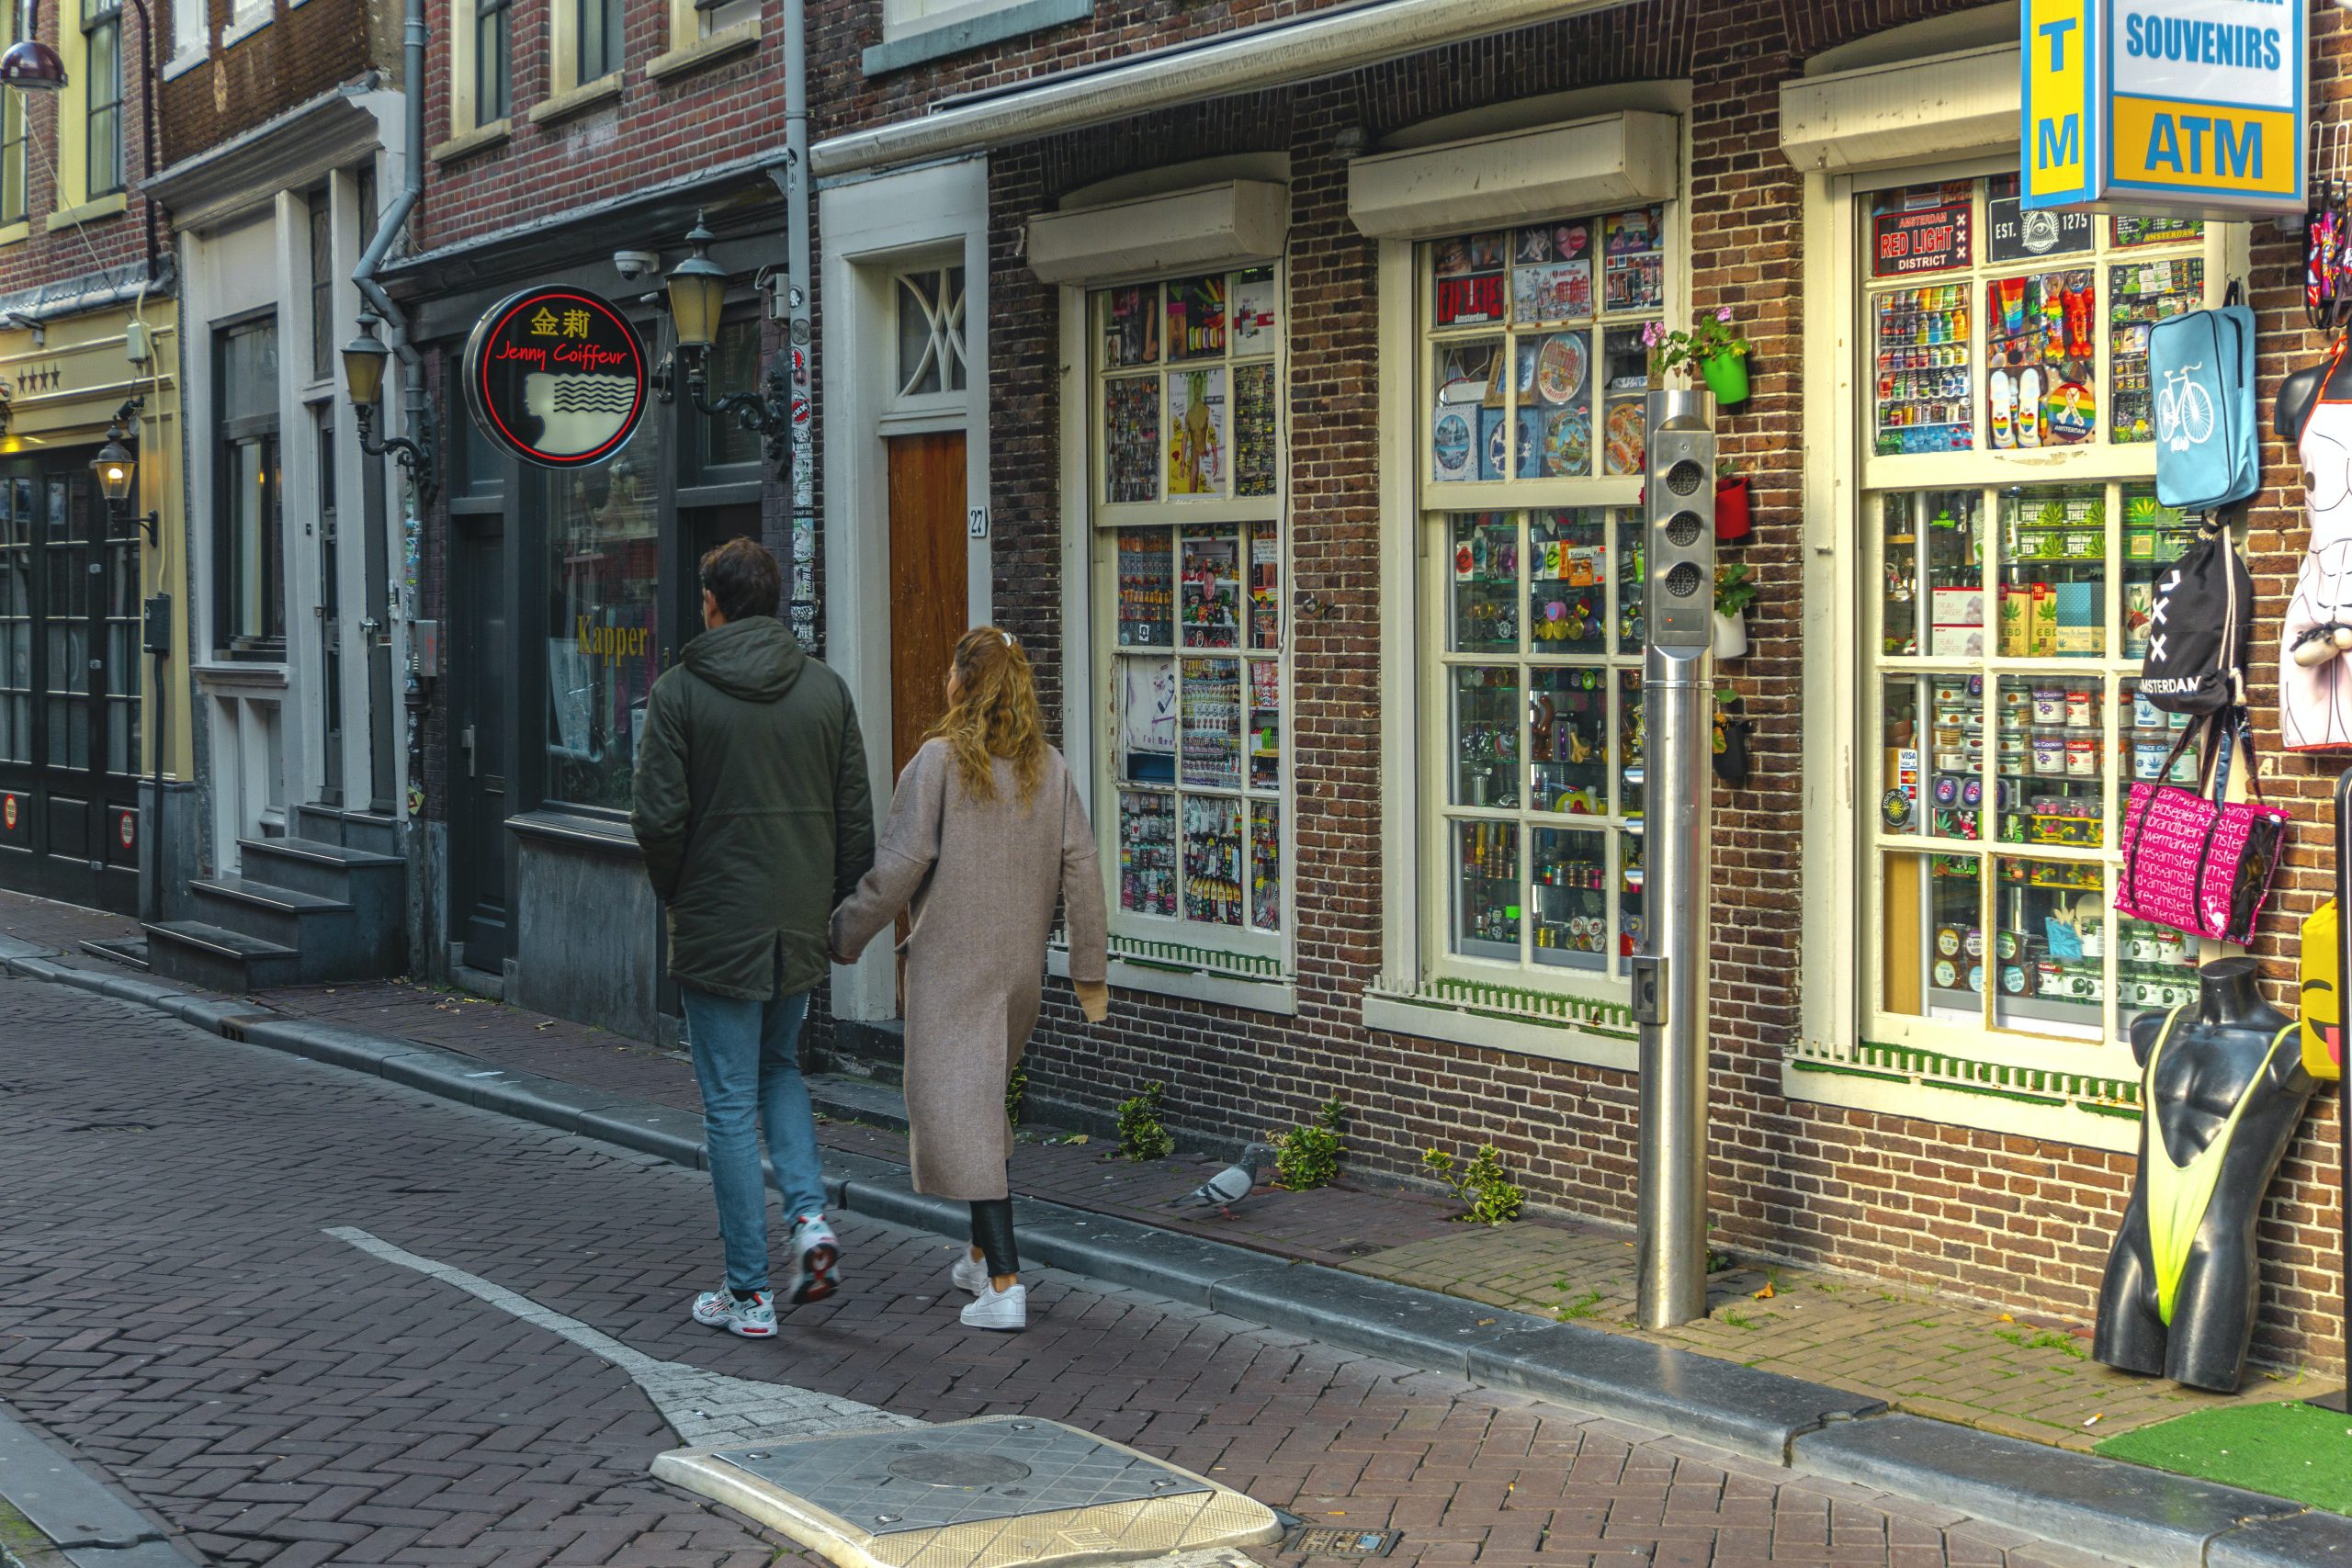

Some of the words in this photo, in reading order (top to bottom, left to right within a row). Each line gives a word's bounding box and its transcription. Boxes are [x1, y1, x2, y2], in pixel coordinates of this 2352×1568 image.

[2125, 12, 2281, 71] SOUVENIRS
[2143, 112, 2263, 179] ATM
[1898, 211, 1948, 229] AMSTERDAM
[2063, 213, 2087, 231] 1275
[1995, 220, 2017, 240] EST.
[2143, 228, 2196, 243] AMSTERDAM
[1880, 231, 1909, 259] RED
[1913, 224, 1954, 255] LIGHT
[1897, 254, 1947, 271] DISTRICT
[530, 307, 592, 339] 金莉
[1454, 312, 1488, 324] Amsterdam
[495, 340, 547, 372] Jenny
[553, 343, 628, 371] Coiffeur
[2053, 424, 2086, 434] AMSTERDAM
[969, 510, 984, 534] 27
[2021, 510, 2040, 522] THEE
[2068, 510, 2086, 521] THEE
[2022, 543, 2035, 554] TEA
[2068, 543, 2086, 554] THEE
[577, 615, 648, 667] Kapper
[1901, 751, 1917, 760] VISA
